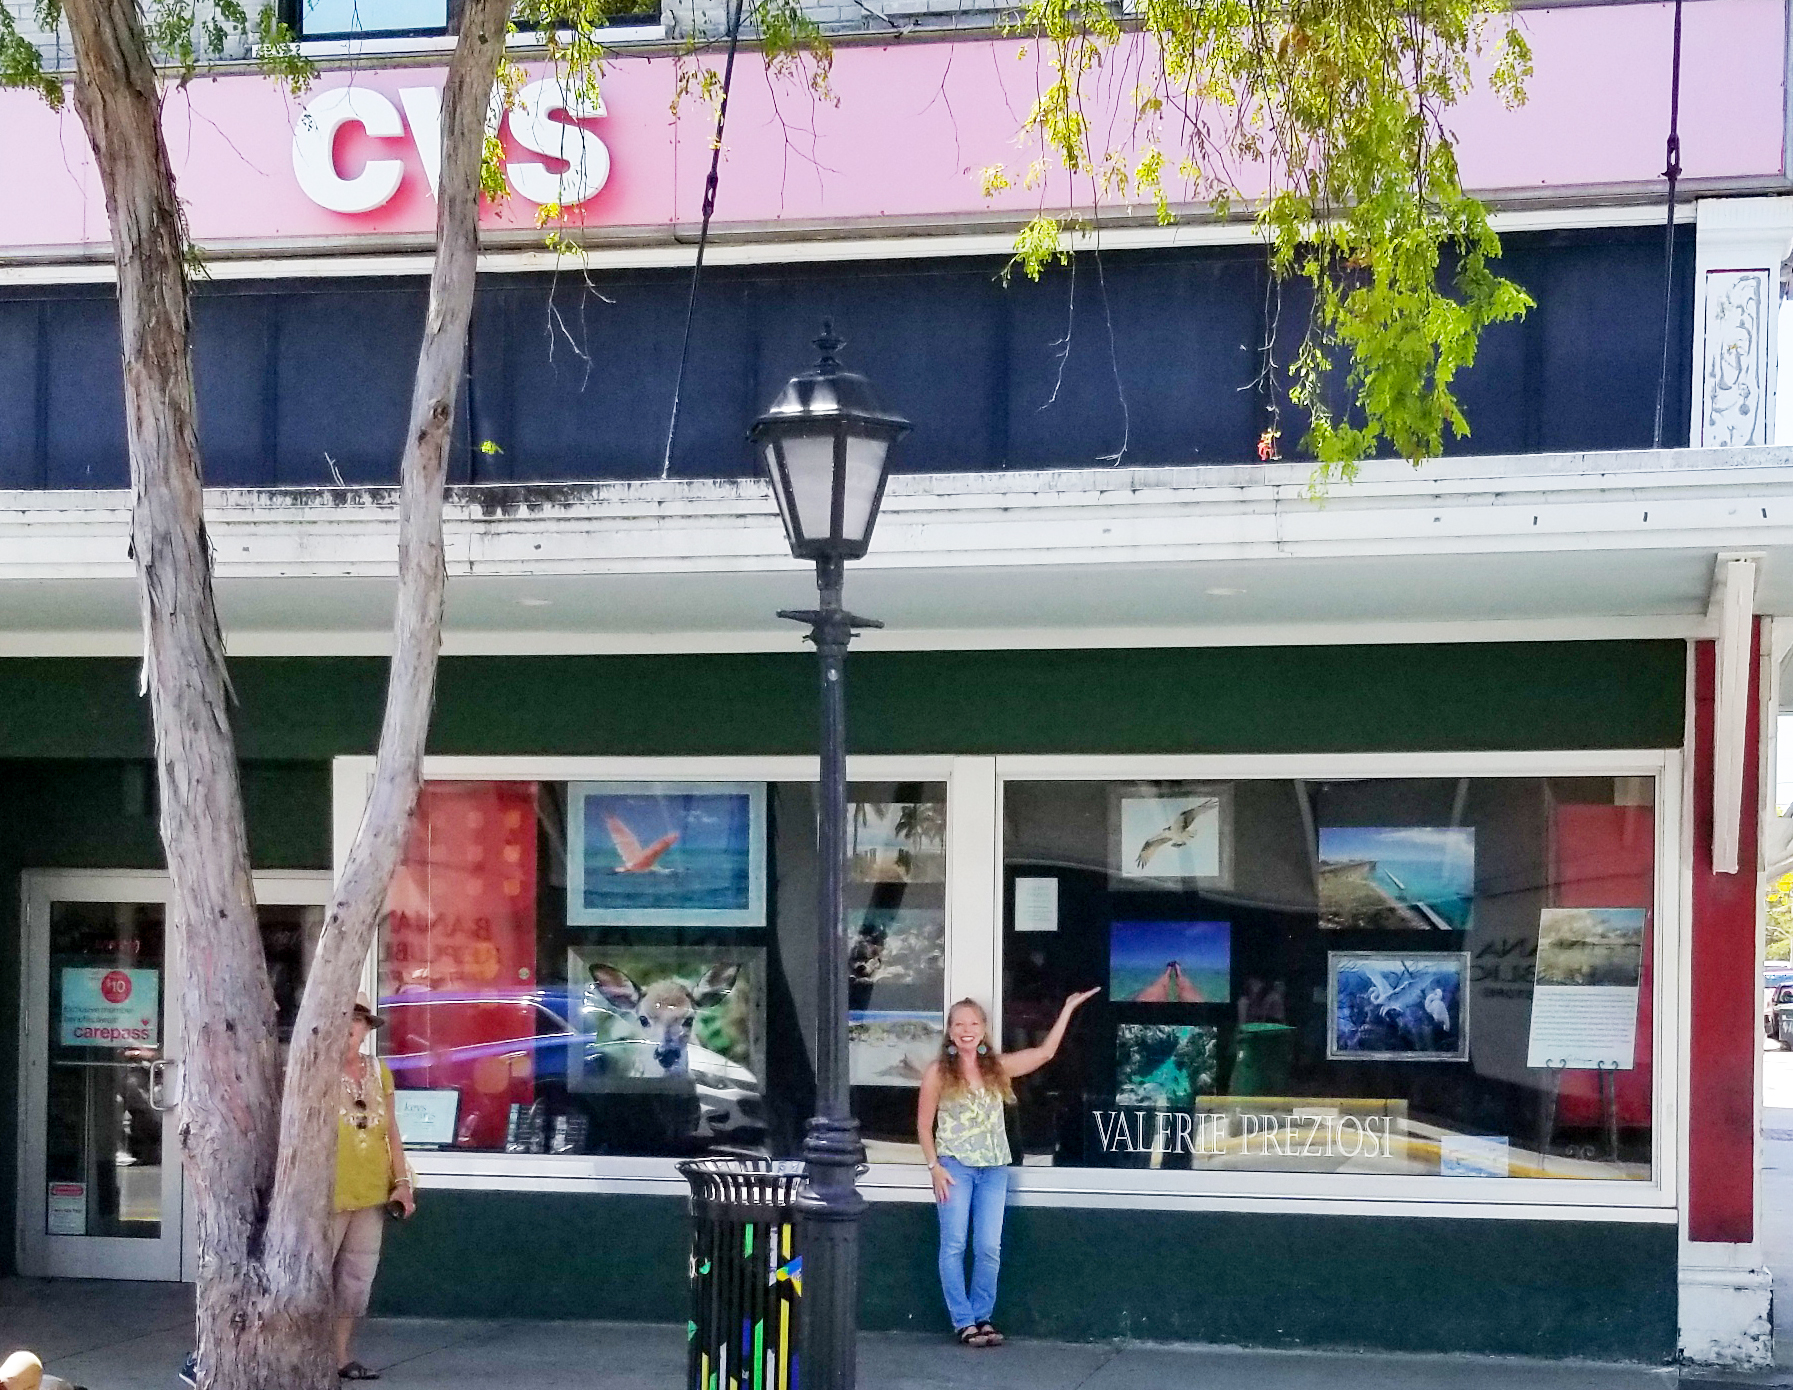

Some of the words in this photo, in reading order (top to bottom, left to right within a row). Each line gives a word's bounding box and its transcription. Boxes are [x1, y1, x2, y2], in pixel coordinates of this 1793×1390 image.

[74, 1027, 150, 1042] carepass
[1092, 1110, 1226, 1155] VALERIE
[1239, 1113, 1394, 1158] PREZIOSI
